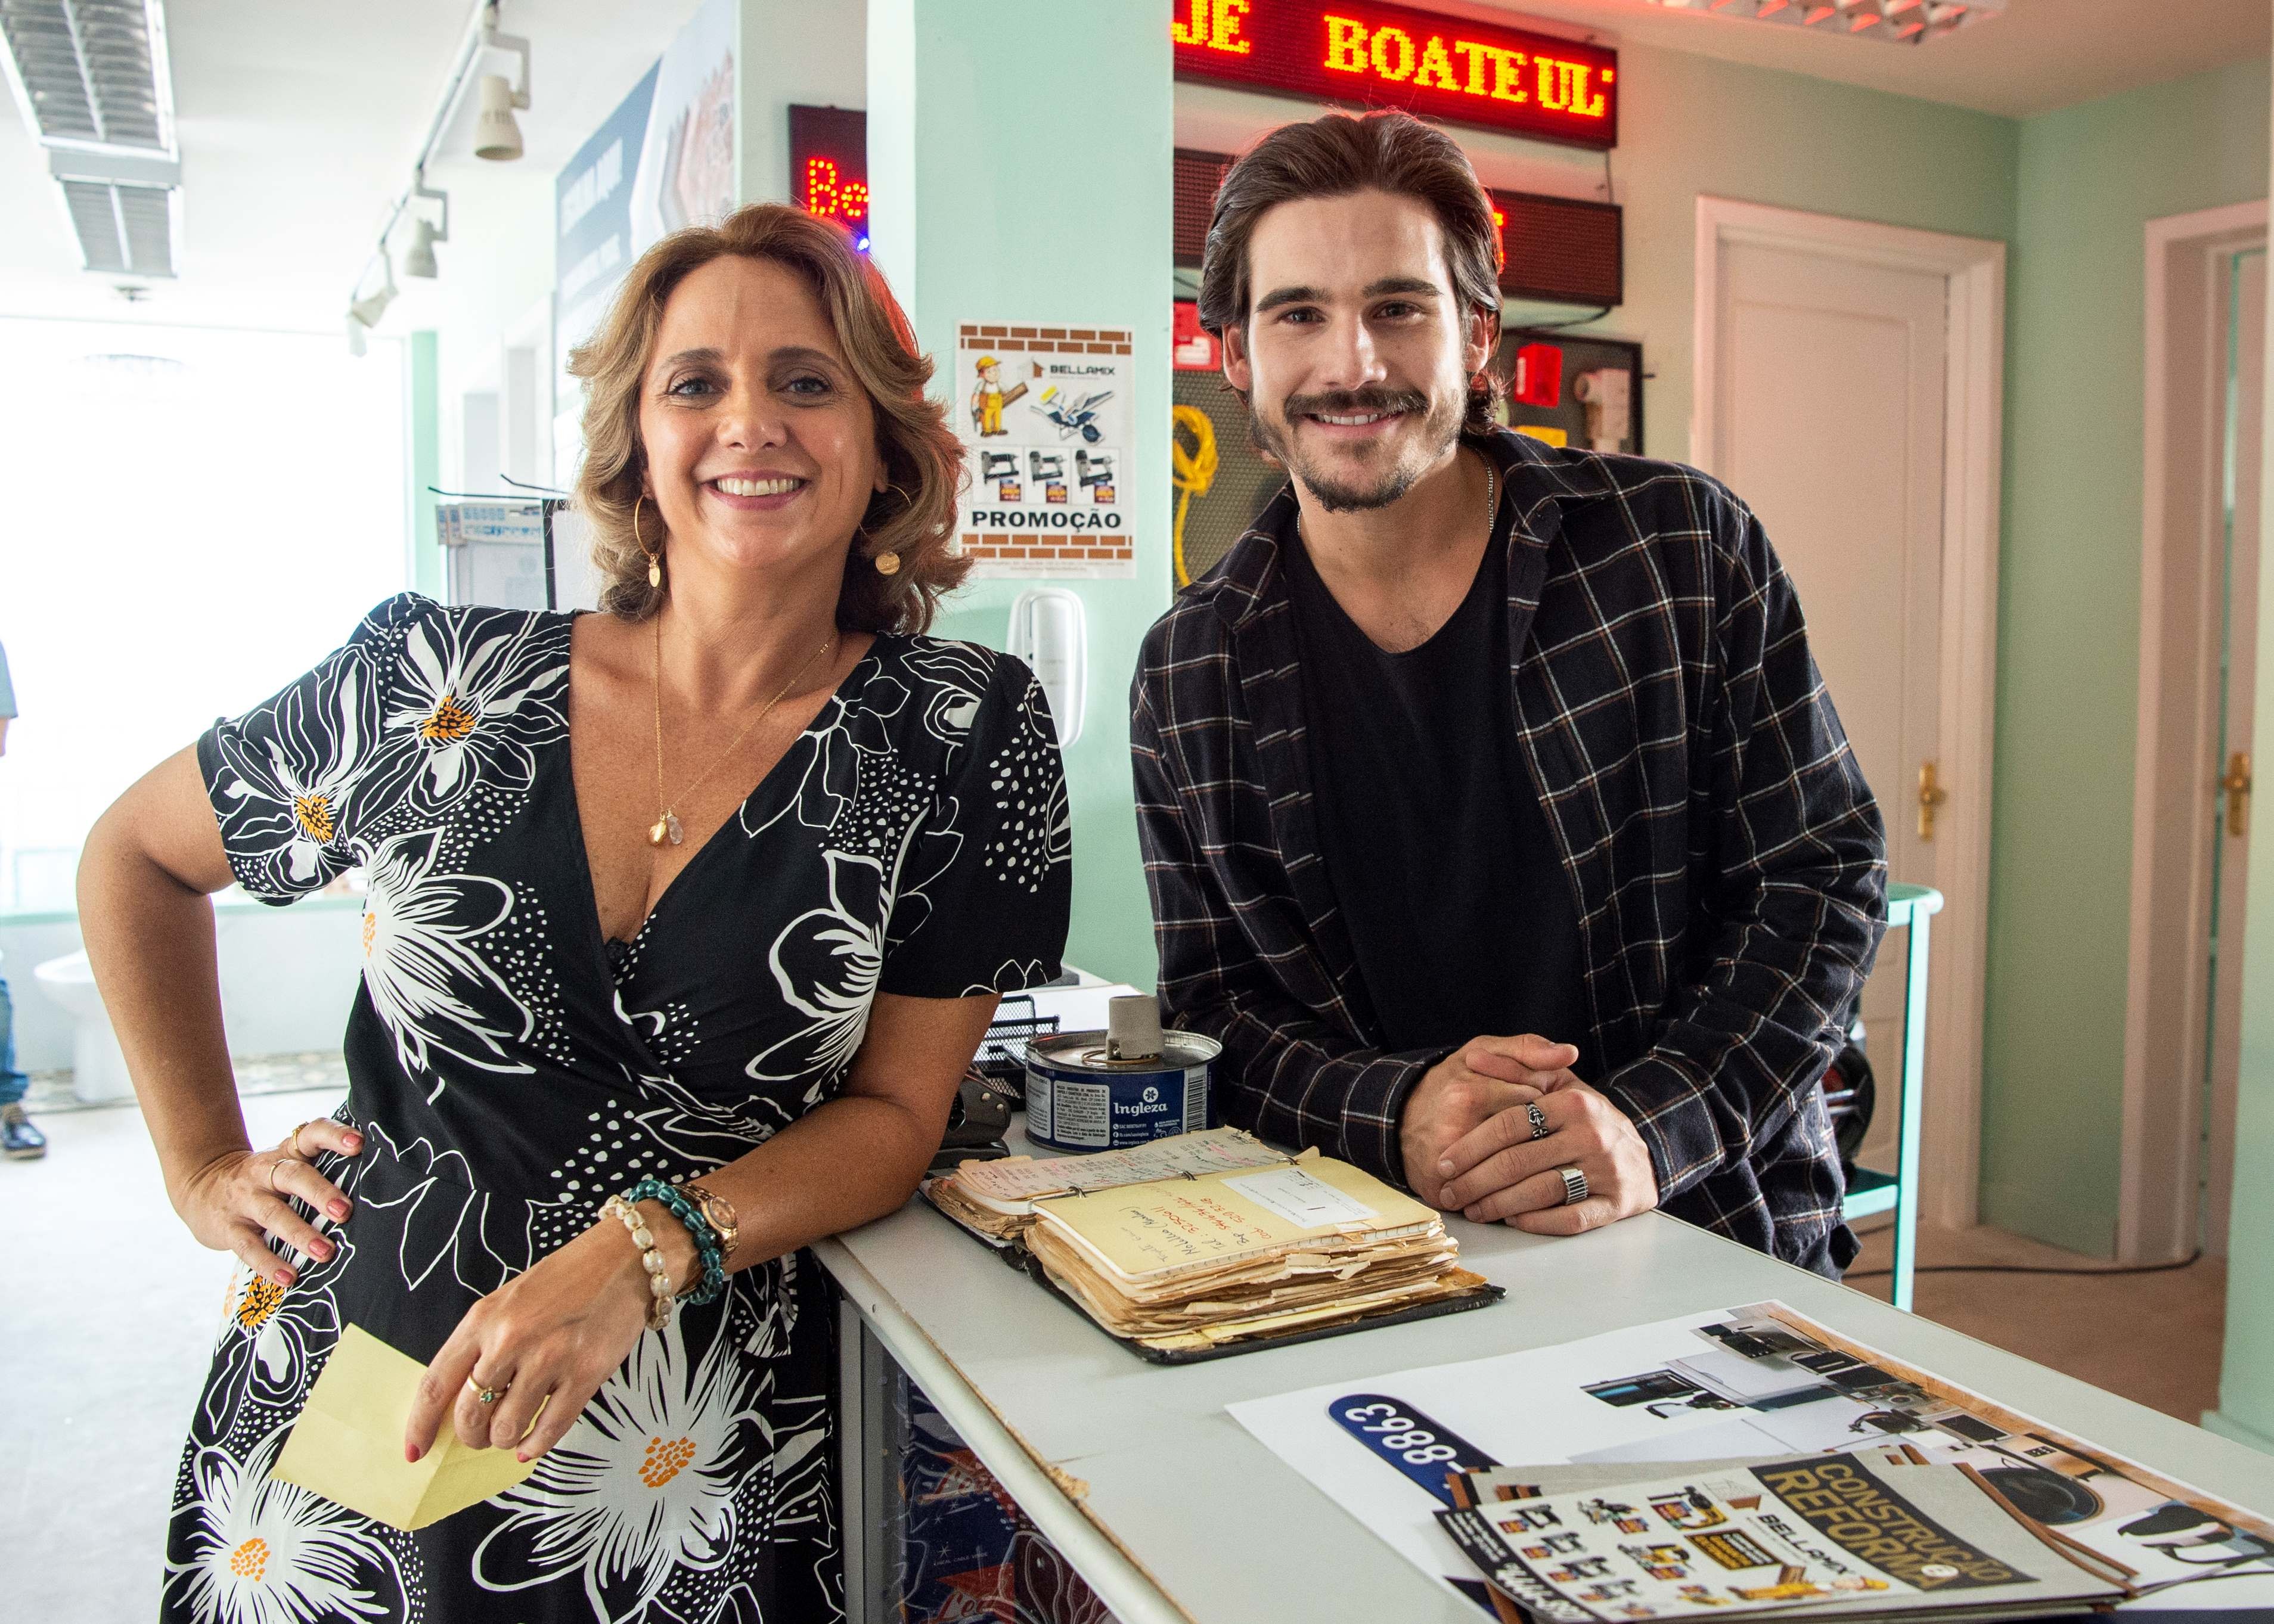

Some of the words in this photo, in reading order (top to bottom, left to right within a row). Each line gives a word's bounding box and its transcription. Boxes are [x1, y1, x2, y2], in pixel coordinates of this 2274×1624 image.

[1324, 15, 1527, 103] BOATE
[1534, 56, 1614, 117] UL
[1049, 364, 1116, 376] BELLAMIX
[972, 508, 1122, 533] PROMOÇÃO
[1113, 1101, 1168, 1117] Ingleza
[1345, 1403, 1466, 1484] -8863
[1763, 1468, 1953, 1589] REFORMA
